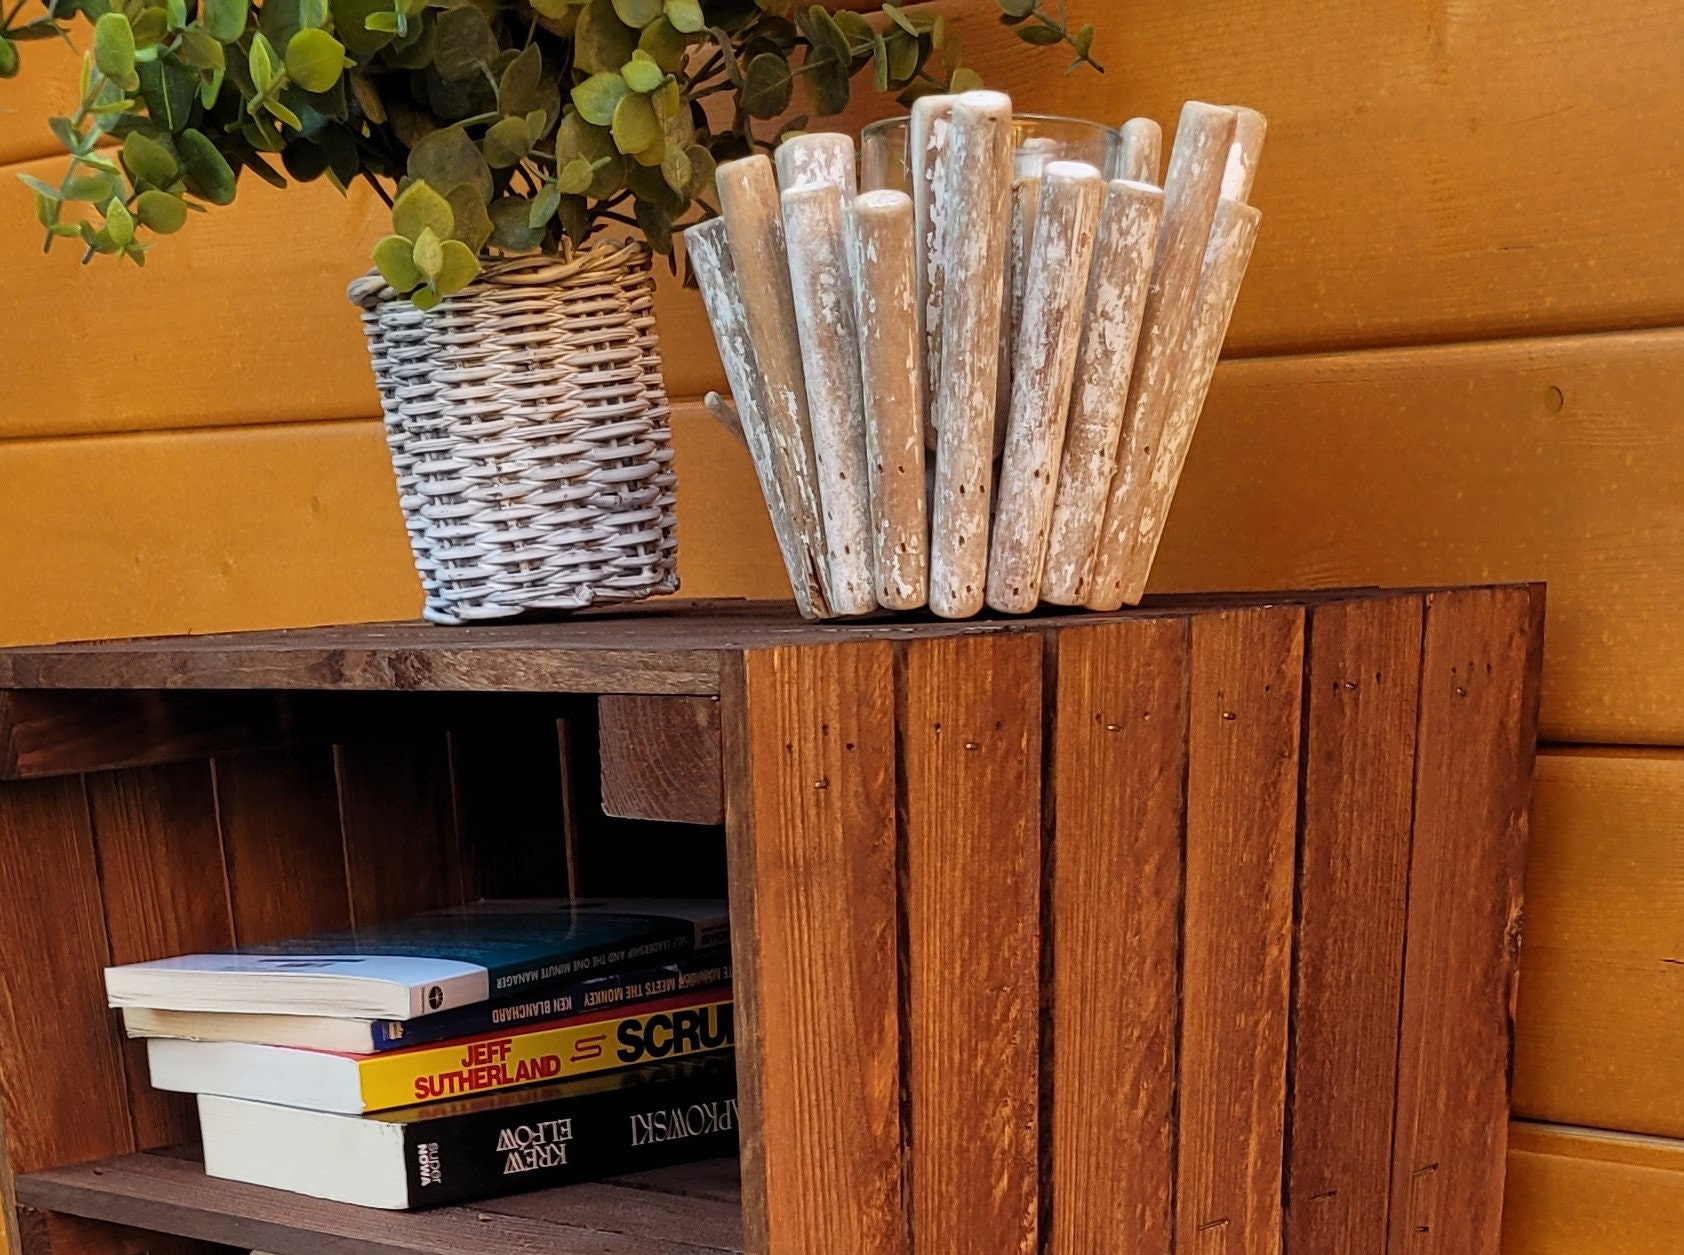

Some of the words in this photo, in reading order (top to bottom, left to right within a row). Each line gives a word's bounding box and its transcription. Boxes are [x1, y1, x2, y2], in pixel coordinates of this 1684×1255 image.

[541, 962, 572, 979] MINUTE
[572, 958, 590, 971] ONE
[592, 954, 607, 967] THE
[496, 969, 540, 989] MANAGER
[645, 978, 676, 996] MEETS
[583, 987, 624, 1008] MONKEY
[626, 983, 643, 1000] THE
[492, 1000, 552, 1024] BLANCHARD
[553, 996, 573, 1013] KEN
[461, 1039, 513, 1067] JEFF
[414, 1055, 562, 1100] SUTHERLAND
[496, 1118, 574, 1151] ELFÓW
[416, 1143, 431, 1187] NOWA
[503, 1143, 568, 1175] KREW
